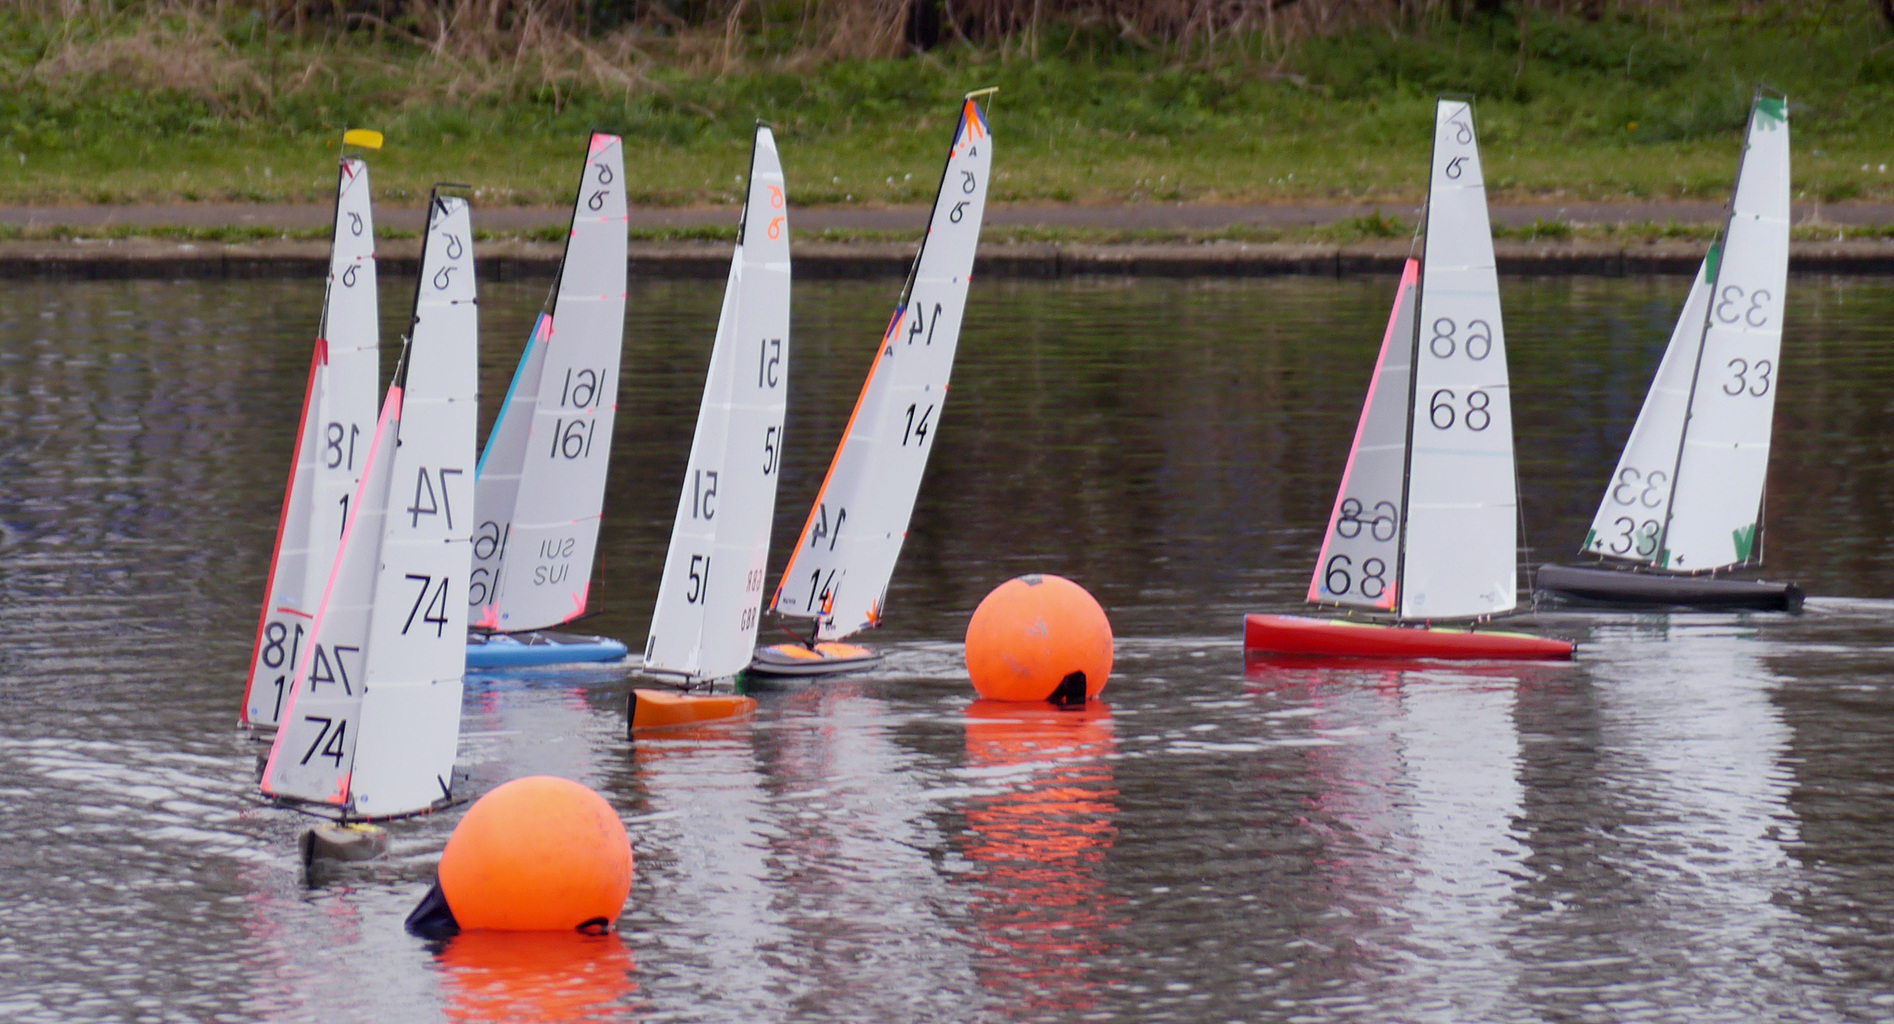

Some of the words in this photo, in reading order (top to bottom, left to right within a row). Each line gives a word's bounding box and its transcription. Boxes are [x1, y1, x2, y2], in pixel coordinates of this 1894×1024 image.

[1722, 357, 1772, 398] 33
[901, 402, 934, 447] 14
[1429, 388, 1491, 432] 68
[550, 418, 596, 459] 161
[763, 425, 782, 476] 51
[1609, 516, 1661, 557] 33
[532, 563, 569, 587] SUI
[686, 553, 711, 606] 51
[806, 568, 836, 613] 14
[1325, 553, 1386, 599] 68
[401, 573, 450, 639] 74
[299, 715, 347, 768] 74
